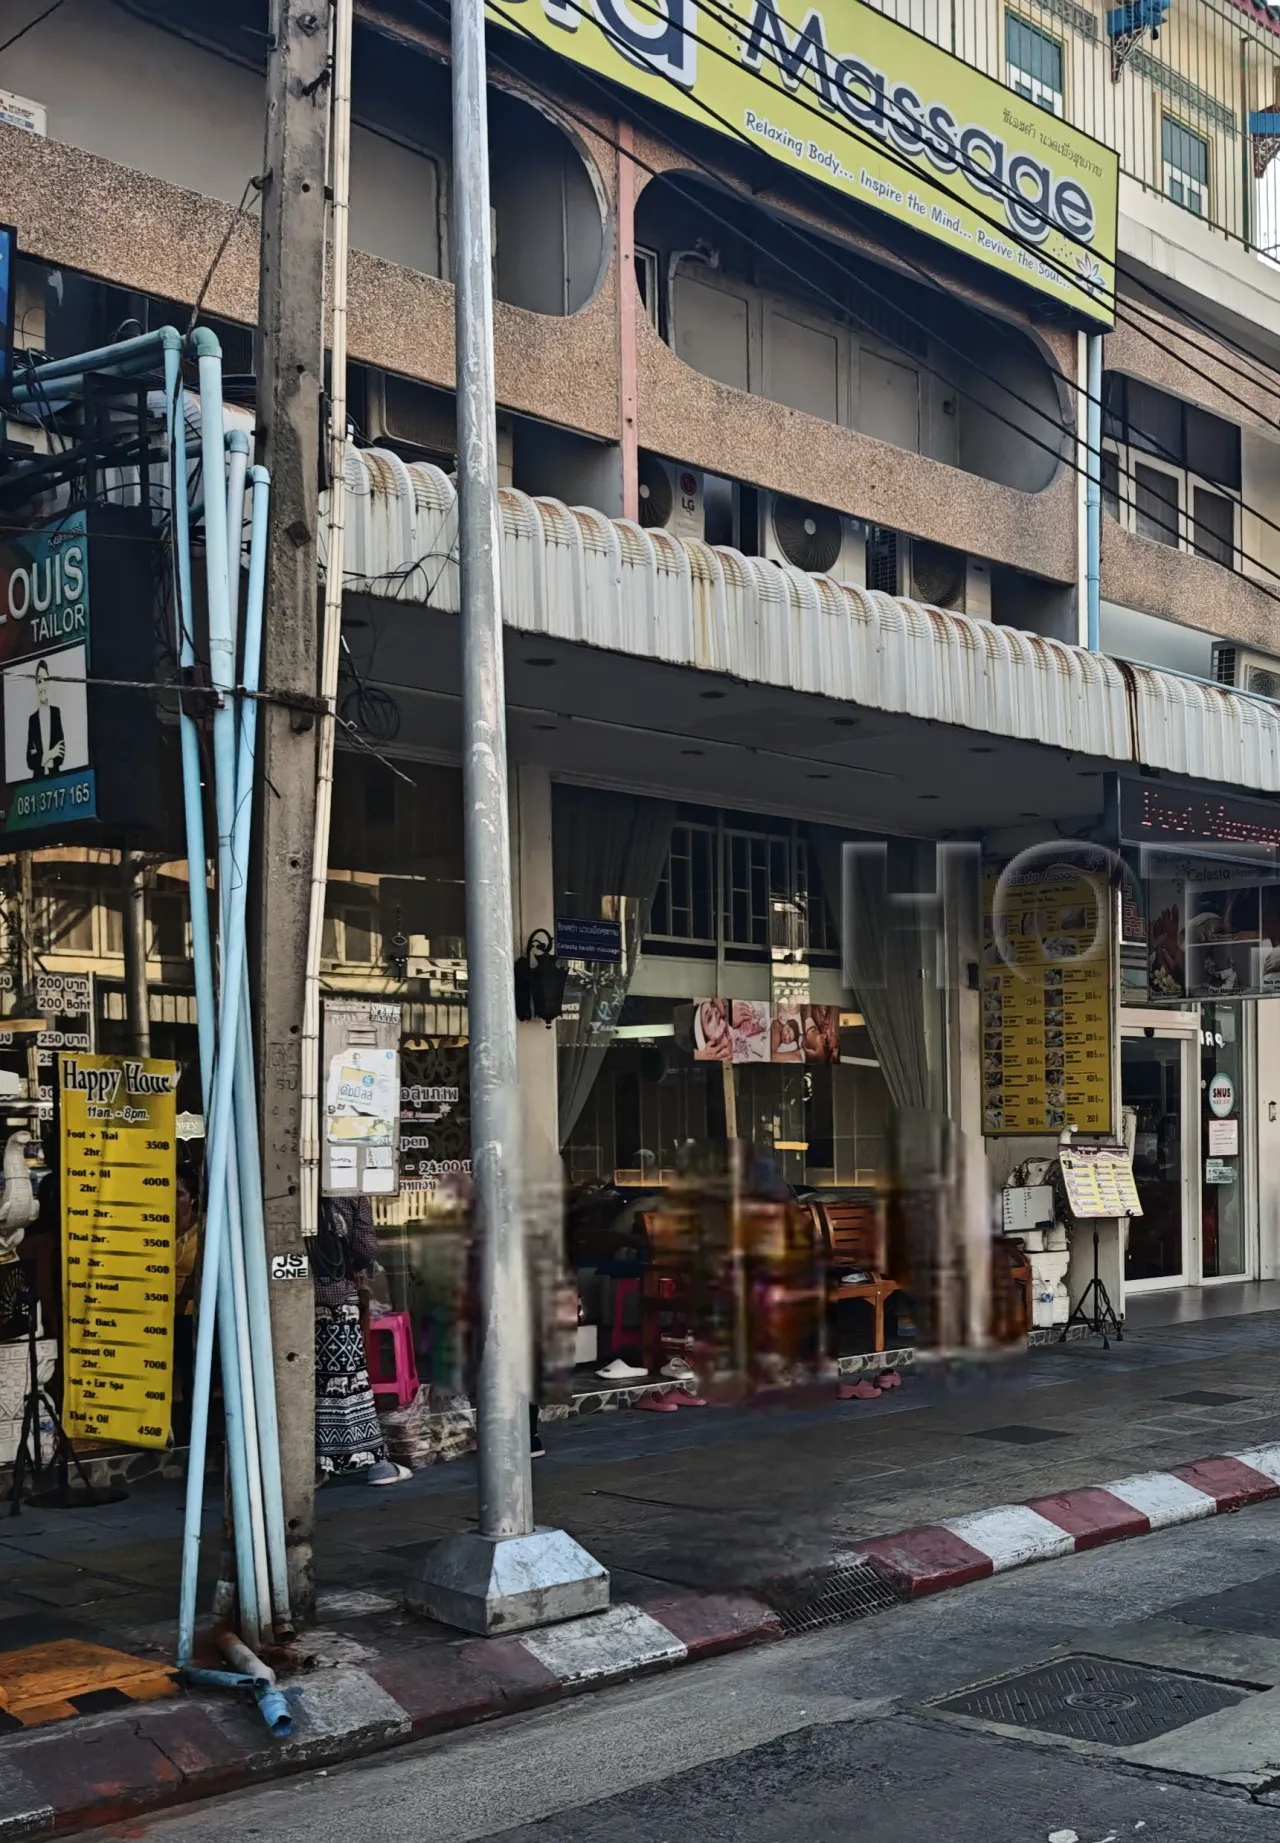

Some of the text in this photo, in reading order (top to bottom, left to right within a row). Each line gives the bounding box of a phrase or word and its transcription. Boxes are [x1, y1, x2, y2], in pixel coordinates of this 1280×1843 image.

[742, 3, 1096, 245] Massage
[745, 111, 803, 156] Relaxing
[808, 143, 854, 174] Body...
[860, 170, 902, 203] Inspire
[908, 193, 926, 214] the
[931, 206, 972, 239] Mind...
[977, 230, 1013, 259] Revive
[1017, 249, 1034, 269] the
[0, 547, 84, 624] OUIS
[31, 604, 86, 643] TAILOR
[17, 782, 90, 816] 081 3717 165
[38, 977, 62, 990] 200
[38, 997, 91, 1010] 200 Baht
[39, 1033, 62, 1045] 250
[39, 1053, 53, 1064] 25
[62, 1060, 172, 1103] Happy Hour
[400, 1085, 459, 1108] อสุขภาพ
[1212, 1087, 1231, 1099] SNUS
[124, 1107, 149, 1121] 8pm.
[67, 1129, 86, 1139] Foot
[101, 1130, 119, 1140] Thai
[401, 1137, 429, 1151] pen
[83, 1147, 103, 1157] 2hr.
[67, 1168, 87, 1178] Foot
[419, 1160, 460, 1174] 24:00
[80, 1183, 100, 1193] 2hr.
[67, 1207, 89, 1217] Foot
[141, 1213, 170, 1223] 350B
[68, 1232, 89, 1242] Thai
[143, 1238, 170, 1248] 350B
[276, 1254, 304, 1268] JS
[145, 1264, 170, 1275] 450B
[272, 1268, 309, 1279] ONE
[95, 1282, 119, 1292] Head
[144, 1292, 170, 1303] 350B
[103, 1348, 116, 1358] Oil
[94, 1378, 107, 1388] Ear
[109, 1381, 124, 1391] Spa
[96, 1414, 110, 1424] Oil
[137, 1425, 162, 1437] 450B
